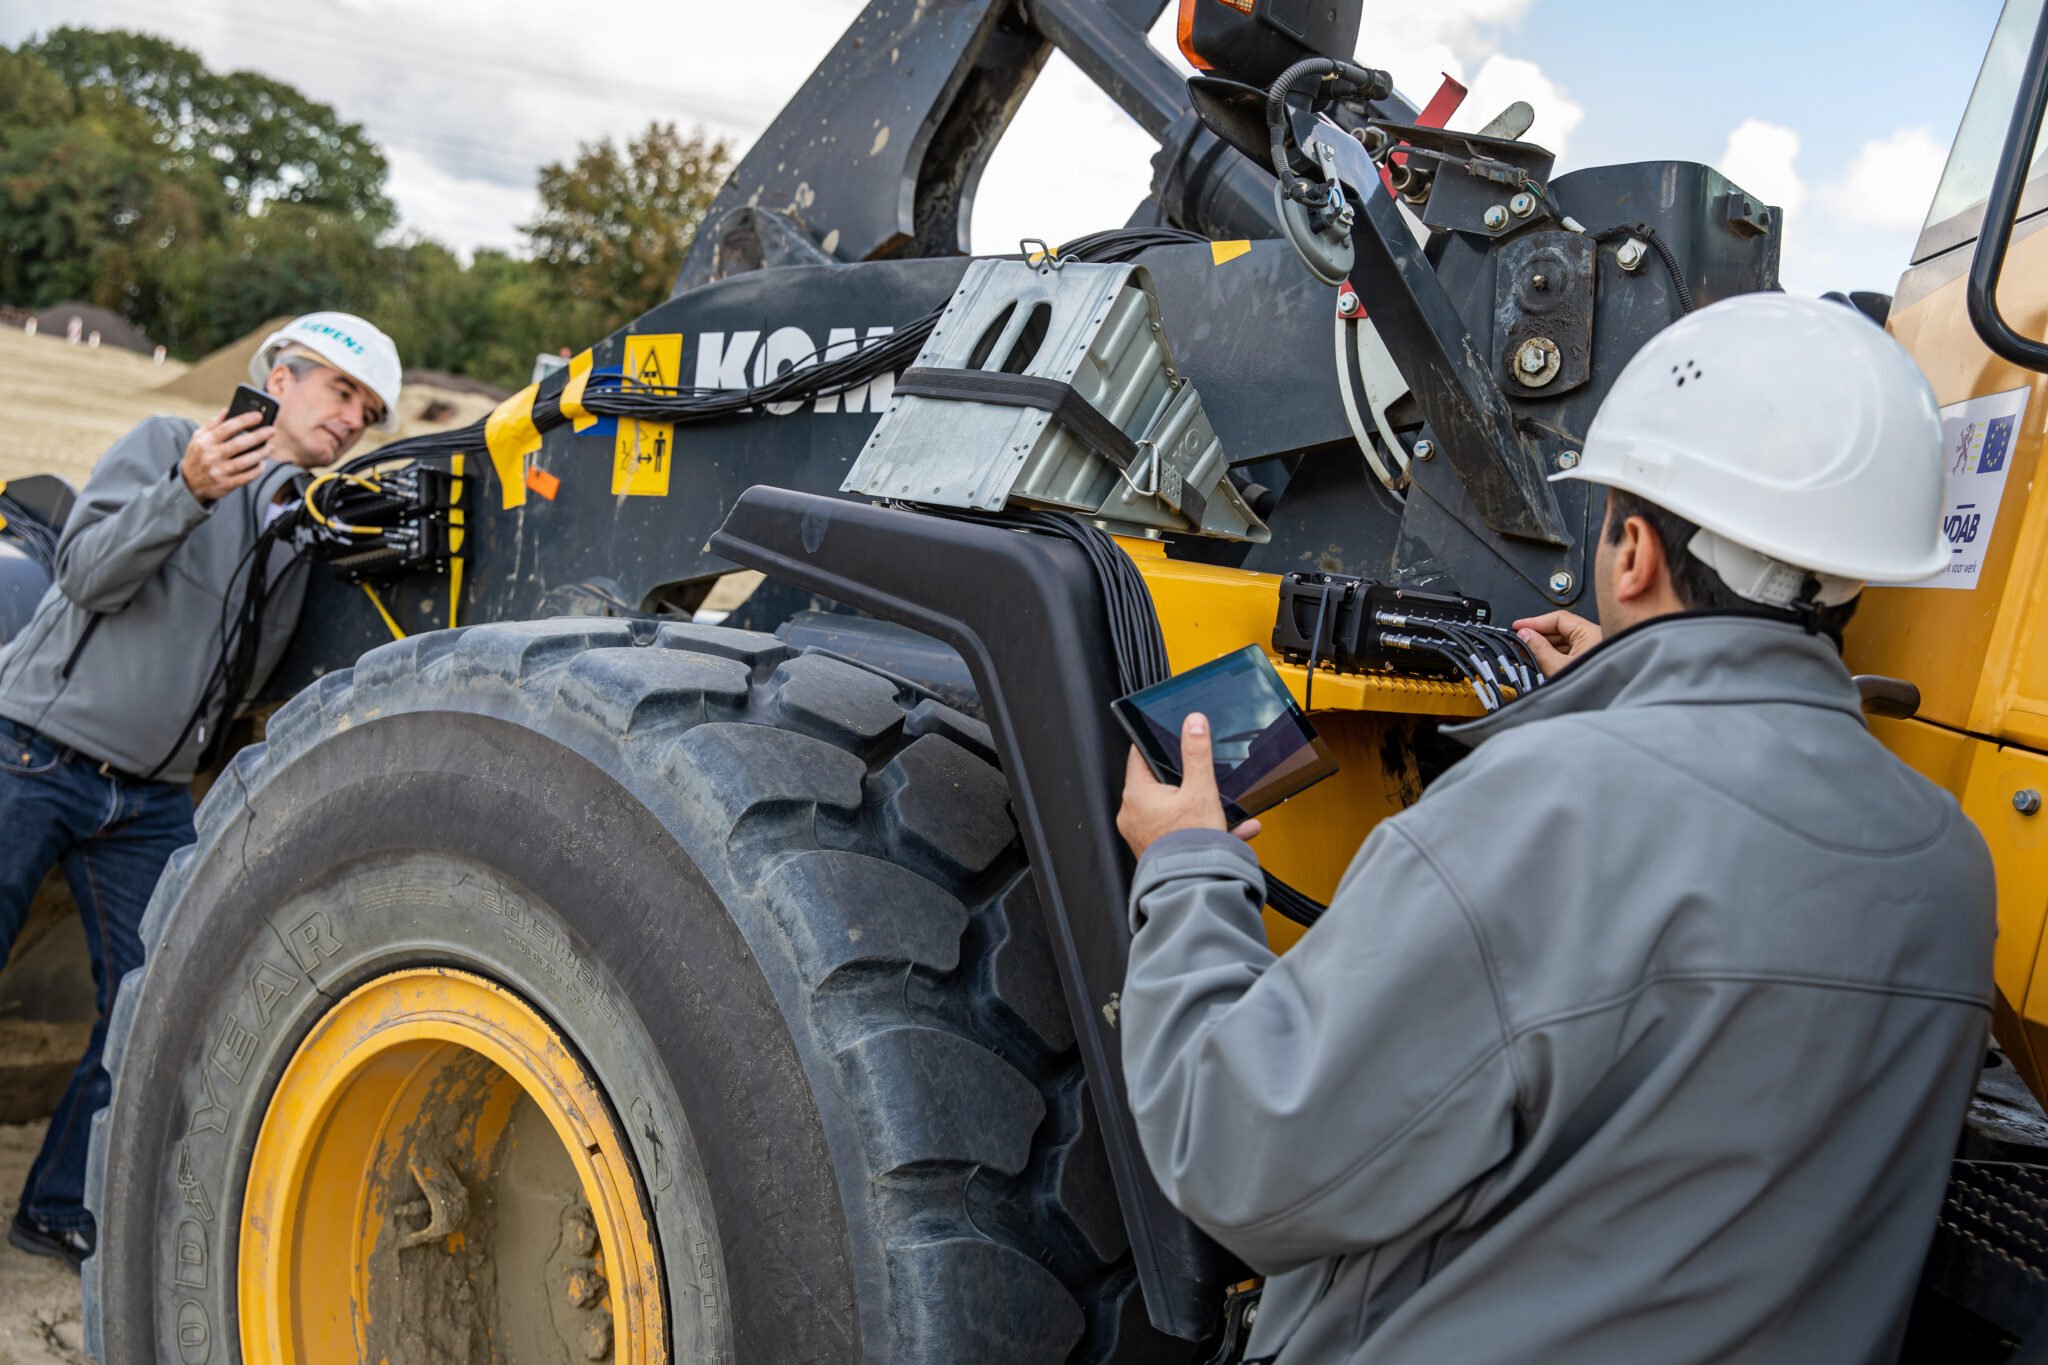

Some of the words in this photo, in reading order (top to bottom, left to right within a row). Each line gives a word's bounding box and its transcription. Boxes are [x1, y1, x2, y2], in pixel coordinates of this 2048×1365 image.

[1943, 513, 1981, 543] VDAB
[1964, 560, 1978, 573] werk
[695, 1240, 722, 1365] RT-
